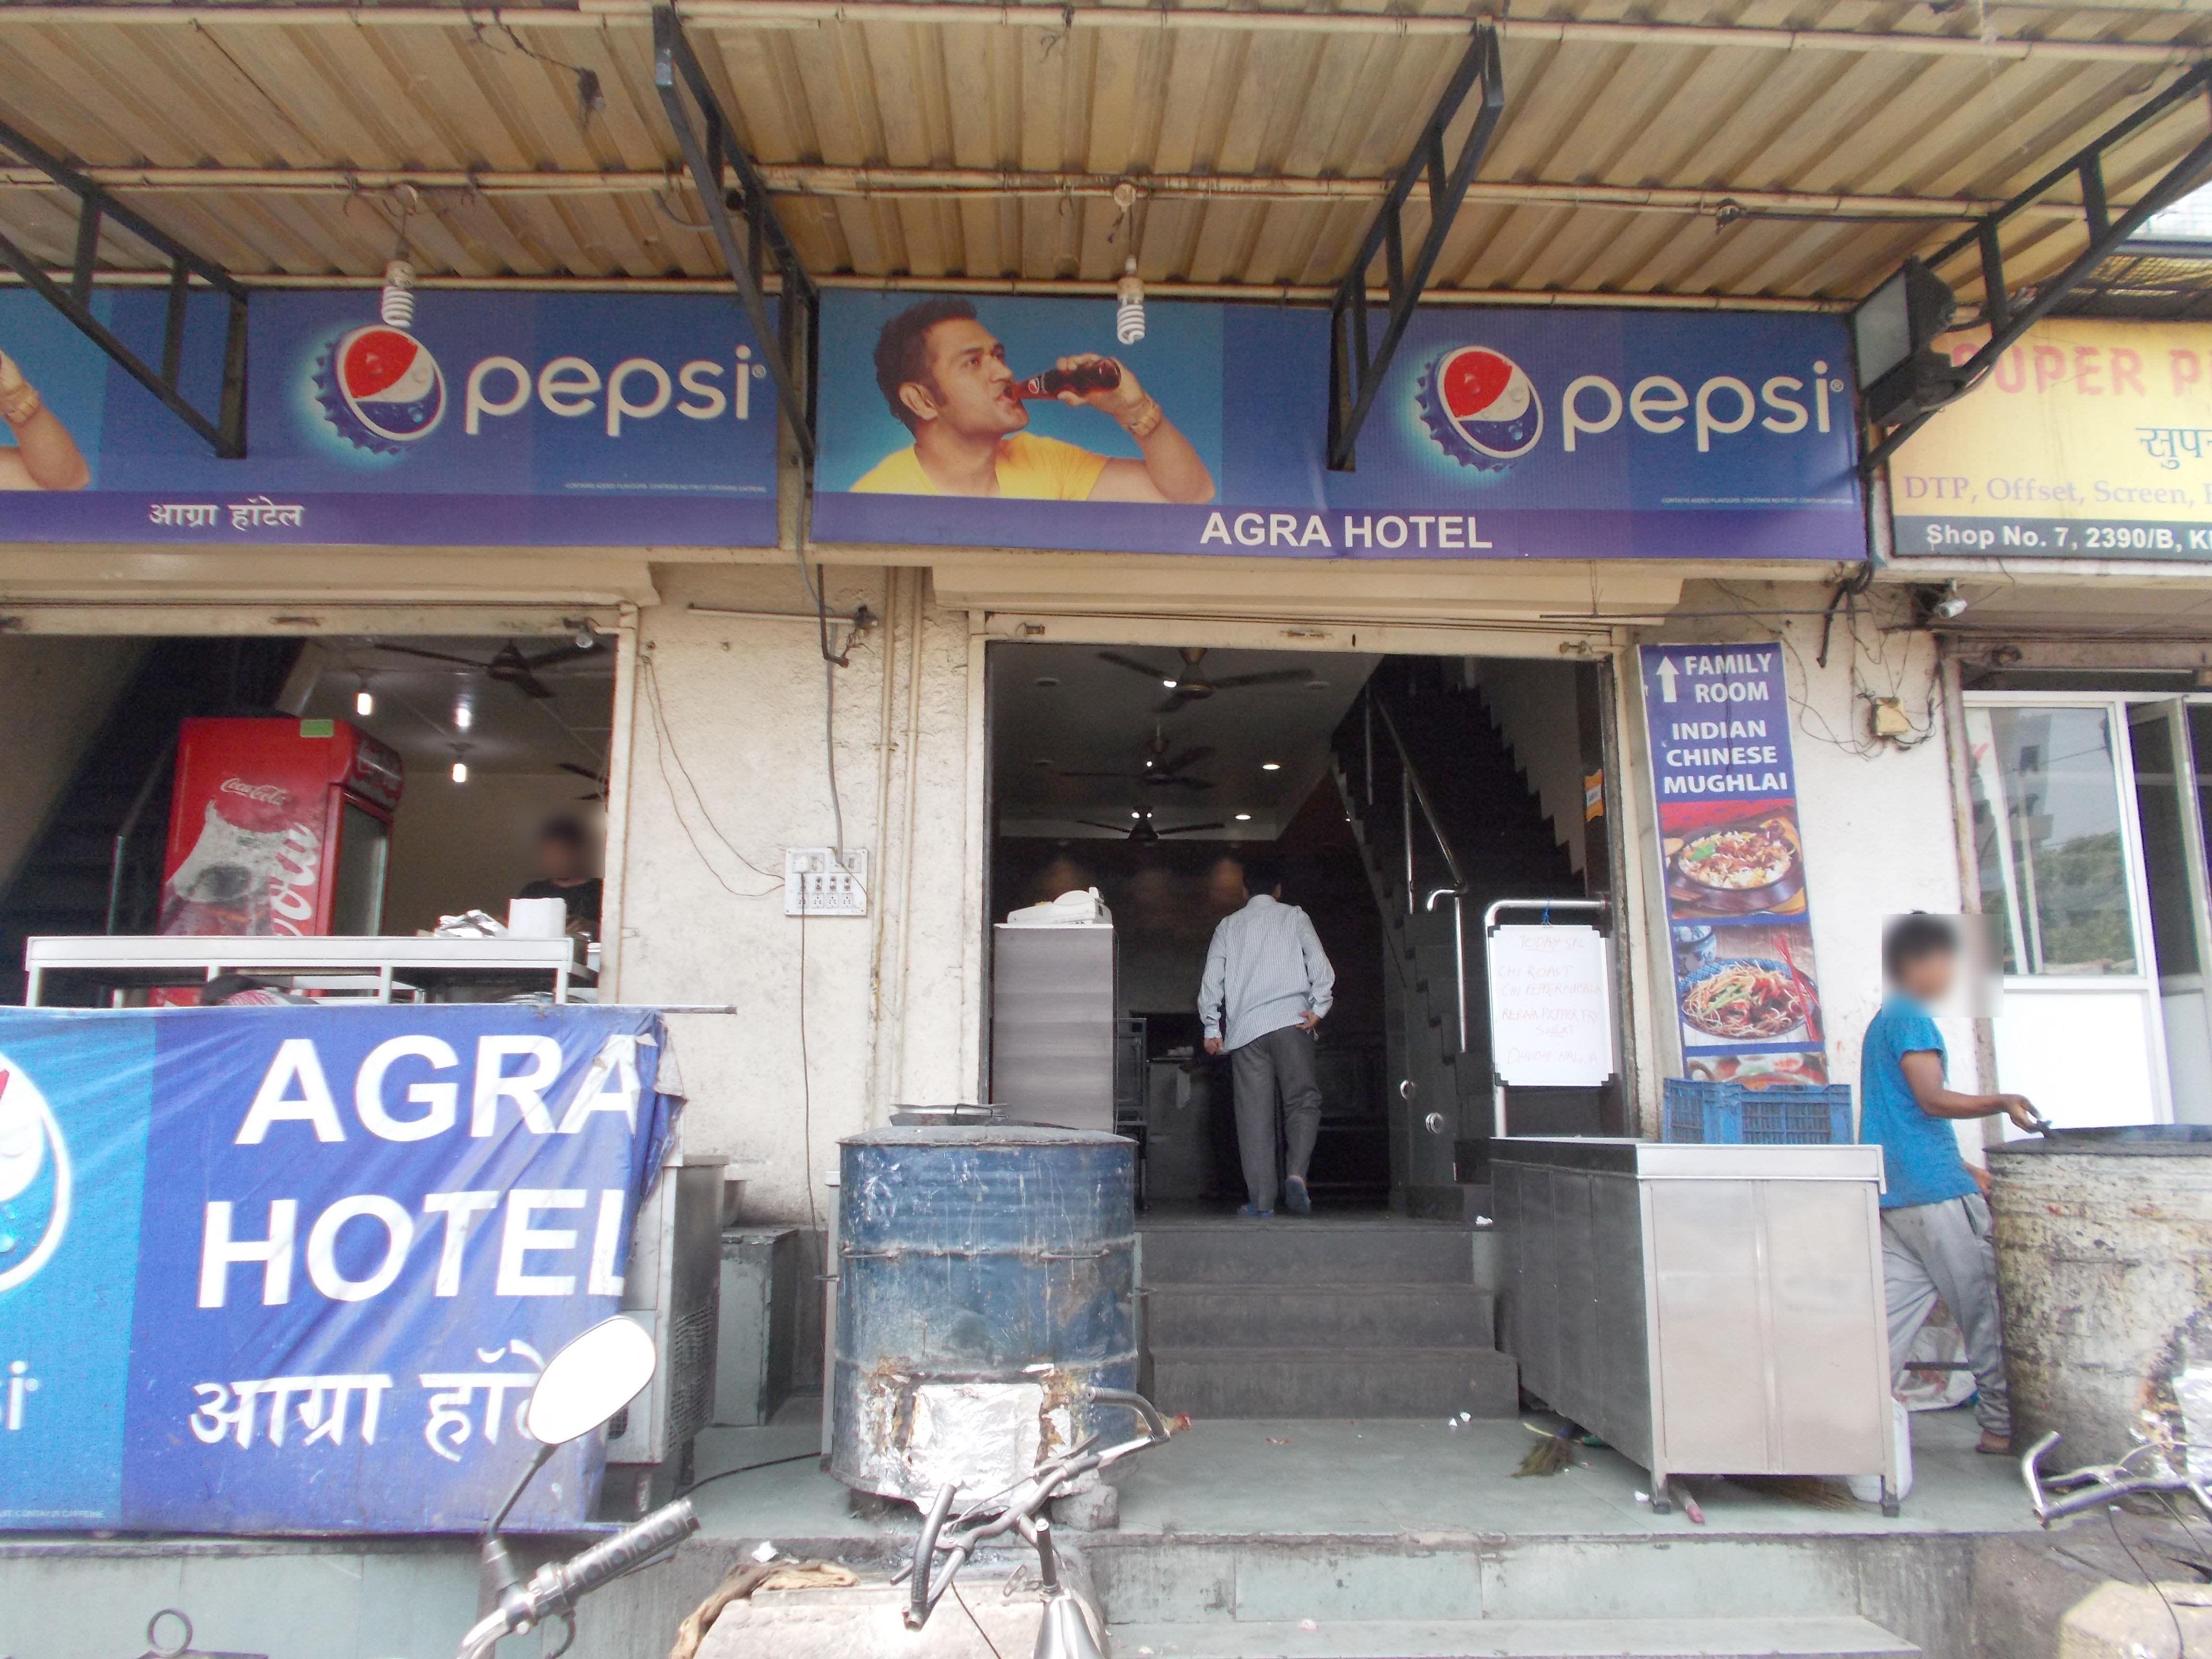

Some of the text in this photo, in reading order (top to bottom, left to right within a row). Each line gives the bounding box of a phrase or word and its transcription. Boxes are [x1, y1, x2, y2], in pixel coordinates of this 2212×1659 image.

[465, 344, 751, 437] pepsi
[2168, 349, 2212, 397] P
[1562, 360, 1830, 452] pepsi
[2135, 427, 2212, 469] सुप
[1904, 476, 1977, 504] DTP,
[1986, 478, 2085, 505] Offset,
[2094, 481, 2195, 508] Screen,
[148, 496, 305, 531] आग्रा हॉटेल
[1200, 512, 1493, 549] AGRA HOTEL
[1926, 524, 1995, 549] Shop
[2003, 525, 2046, 547] No.
[2086, 527, 2183, 552] 2390/B,
[2189, 529, 2212, 549] K
[1685, 653, 1772, 675] FAMILY
[1695, 682, 1769, 703] ROOM
[1672, 720, 1767, 740] INDIAN
[1666, 746, 1778, 767] CHINESE
[1664, 772, 1788, 794] MUGHLAI
[1527, 965, 1573, 979] ROAST
[235, 1034, 639, 1144] AGRA
[198, 1188, 625, 1309] HOTEL
[190, 1339, 545, 1463] आग्रा हॉ
